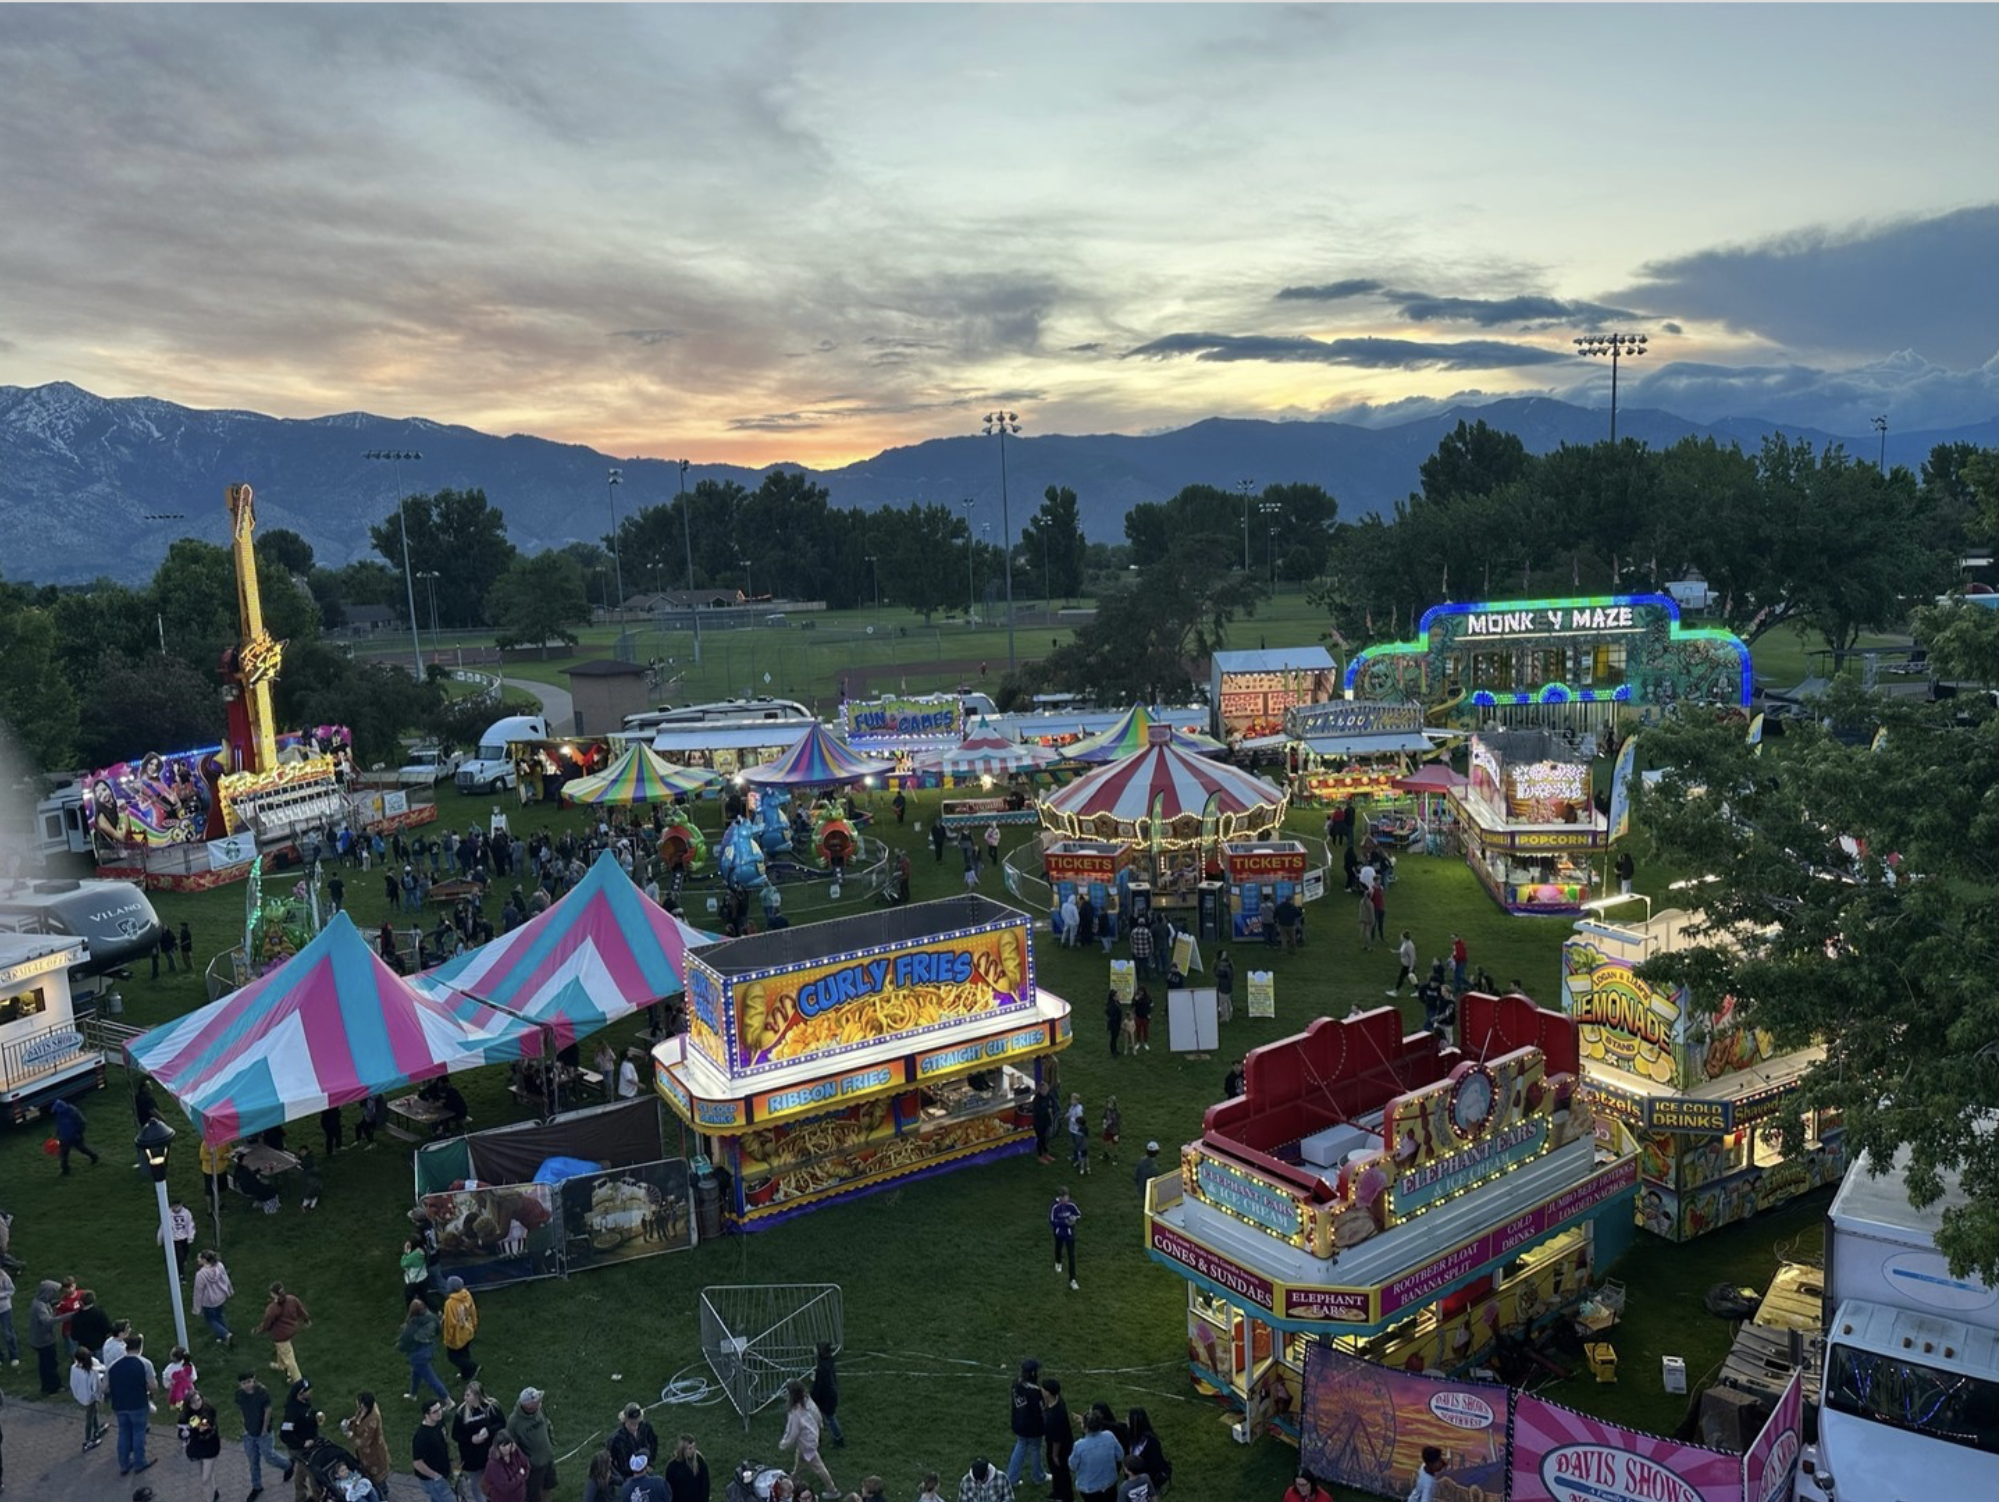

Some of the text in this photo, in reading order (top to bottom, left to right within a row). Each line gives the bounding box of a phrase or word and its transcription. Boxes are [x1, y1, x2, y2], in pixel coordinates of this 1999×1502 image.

[1572, 607, 1633, 629] MAZE
[1222, 694, 1261, 702] HOOP
[854, 710, 886, 733] FUN
[899, 711, 955, 734] GAMES
[1519, 834, 1588, 845] POPCORN
[1047, 857, 1113, 870] TICKETS
[1233, 856, 1303, 869] TICKETS
[88, 903, 142, 922] VILANO
[798, 953, 973, 1017] CURLY FRIES
[1572, 989, 1671, 1056] LEMONADE
[921, 1045, 983, 1073] STRAIGHT
[986, 1037, 1008, 1058] CUT
[1011, 1028, 1046, 1049] FRIES
[1606, 1035, 1636, 1051] STAND
[768, 1069, 891, 1113] RIBBON FRIES
[1655, 1101, 1722, 1114] ICE COLD
[1734, 1098, 1780, 1121] Shaved
[1653, 1113, 1725, 1130] DRINKS
[1401, 1121, 1538, 1195] ELEPHANT EARS
[1433, 1153, 1511, 1197] & ICE CREAM
[1202, 1166, 1295, 1218] ELEPHANT EARS
[1548, 1161, 1637, 1215] JUMBO BEEF HOTDOGS
[1558, 1179, 1628, 1221] LOADED NACHOS
[1208, 1182, 1289, 1228] & ICE CREAM
[1507, 1214, 1533, 1235] COLD
[1501, 1227, 1536, 1252] DRINKS
[1154, 1234, 1273, 1308] CONES & SUNDAES
[1393, 1241, 1480, 1295] ROOTBEER FLOAT
[1400, 1260, 1472, 1306] BANANA SPLIT
[1291, 1292, 1364, 1308] ELEPHANT
[1312, 1304, 1346, 1316] EARS
[1435, 1393, 1460, 1408] DAVIS
[1461, 1394, 1490, 1415] SHOWS
[1440, 1411, 1483, 1427] NORTHWEST
[1556, 1450, 1616, 1488] DAVIS
